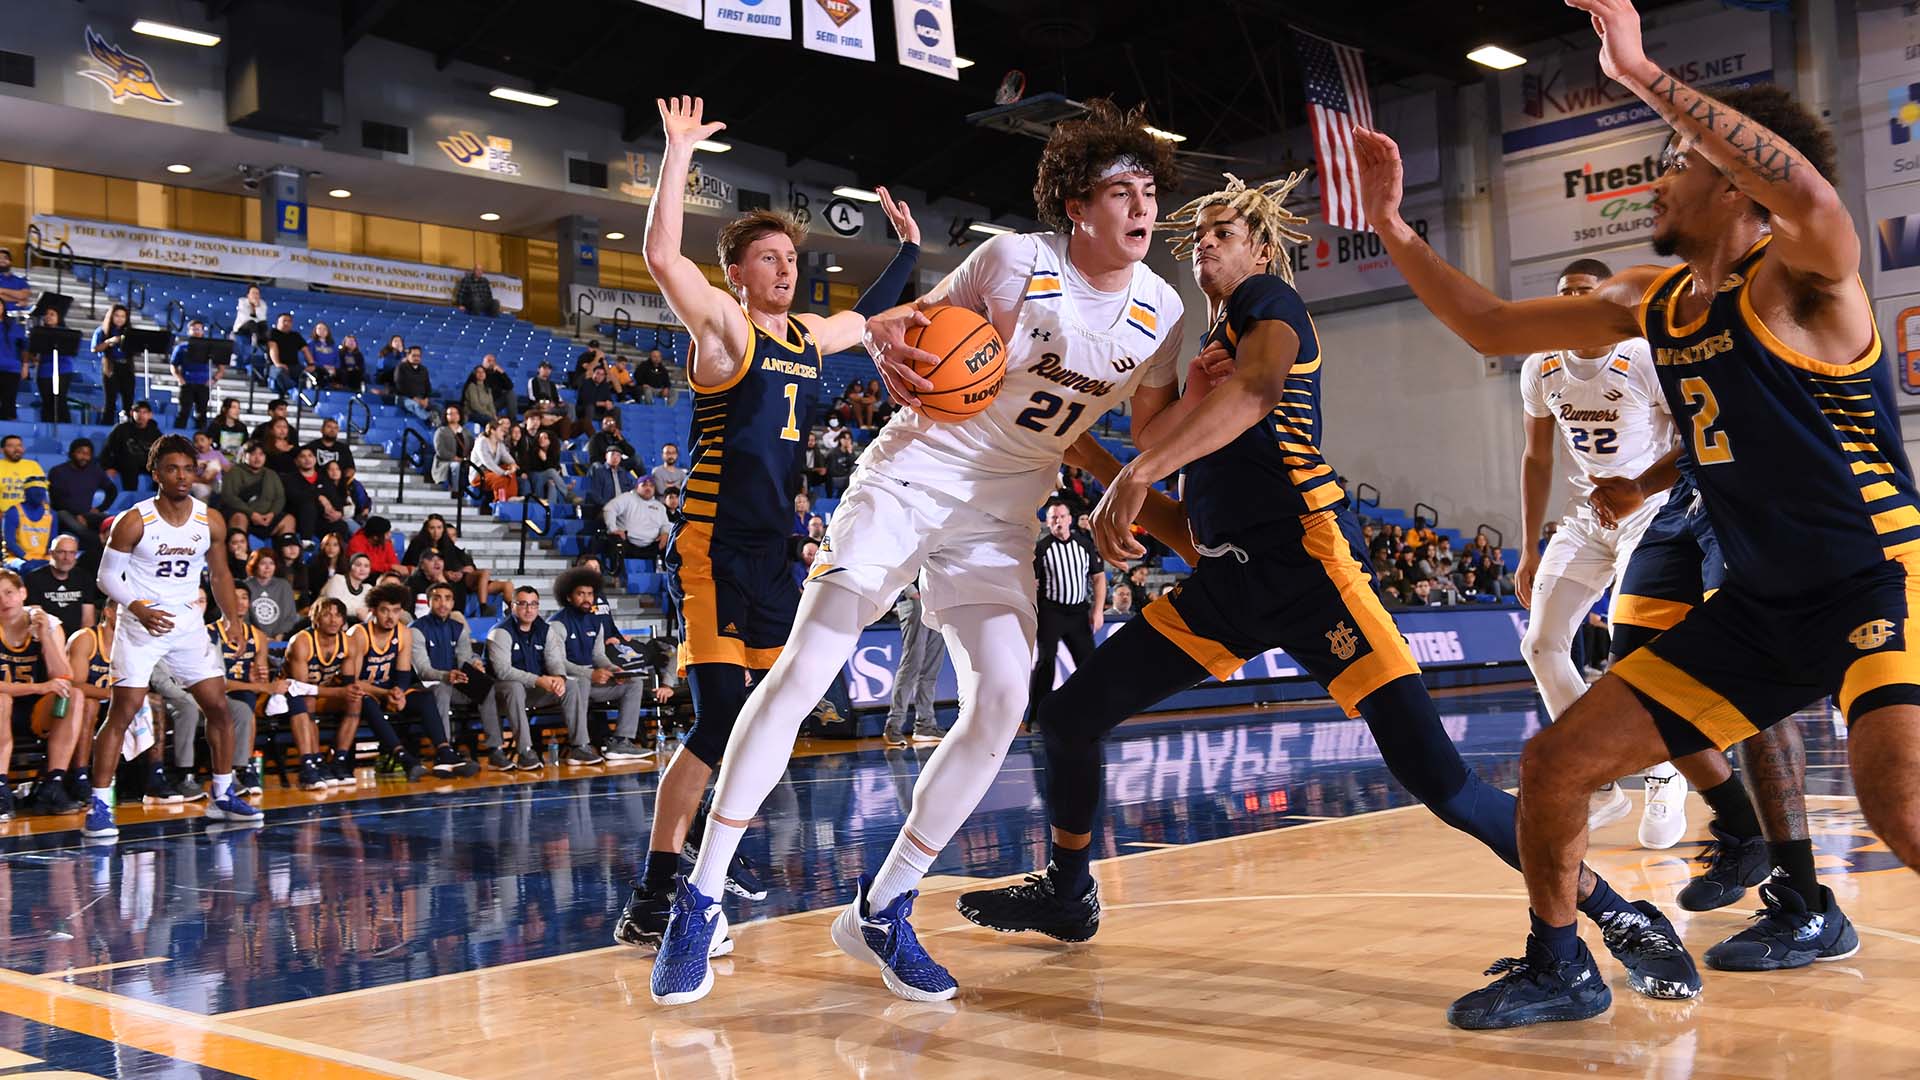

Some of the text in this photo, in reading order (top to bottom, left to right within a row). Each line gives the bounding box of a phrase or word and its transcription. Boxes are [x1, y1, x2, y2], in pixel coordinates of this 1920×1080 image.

[717, 8, 782, 26] FIRST ROUND
[816, 30, 863, 48] SEMI FINAL
[908, 48, 926, 60] FIRST
[1596, 111, 1627, 128] YOUR
[1564, 154, 1662, 199] Firest
[1893, 157, 1920, 173] Sol
[703, 175, 732, 202] POLY
[284, 205, 300, 230] 9
[1573, 216, 1656, 242] 3501 CALIFO
[74, 225, 280, 259] THE LAW OFFICES OF DIXON KUMMER
[139, 248, 219, 267] 661-324-2700
[333, 272, 374, 286] SERVING
[339, 261, 374, 272] ESTATE
[376, 264, 420, 279] PLANNING
[588, 288, 666, 310] NOW IN THE
[964, 335, 1002, 375] NCAA
[1027, 352, 1116, 398] Runners
[780, 383, 800, 442] 1
[1015, 391, 1086, 437] 21
[1560, 403, 1620, 422] Runners
[1680, 376, 1735, 465] 2
[1570, 427, 1620, 454] 22
[155, 560, 190, 577] 23
